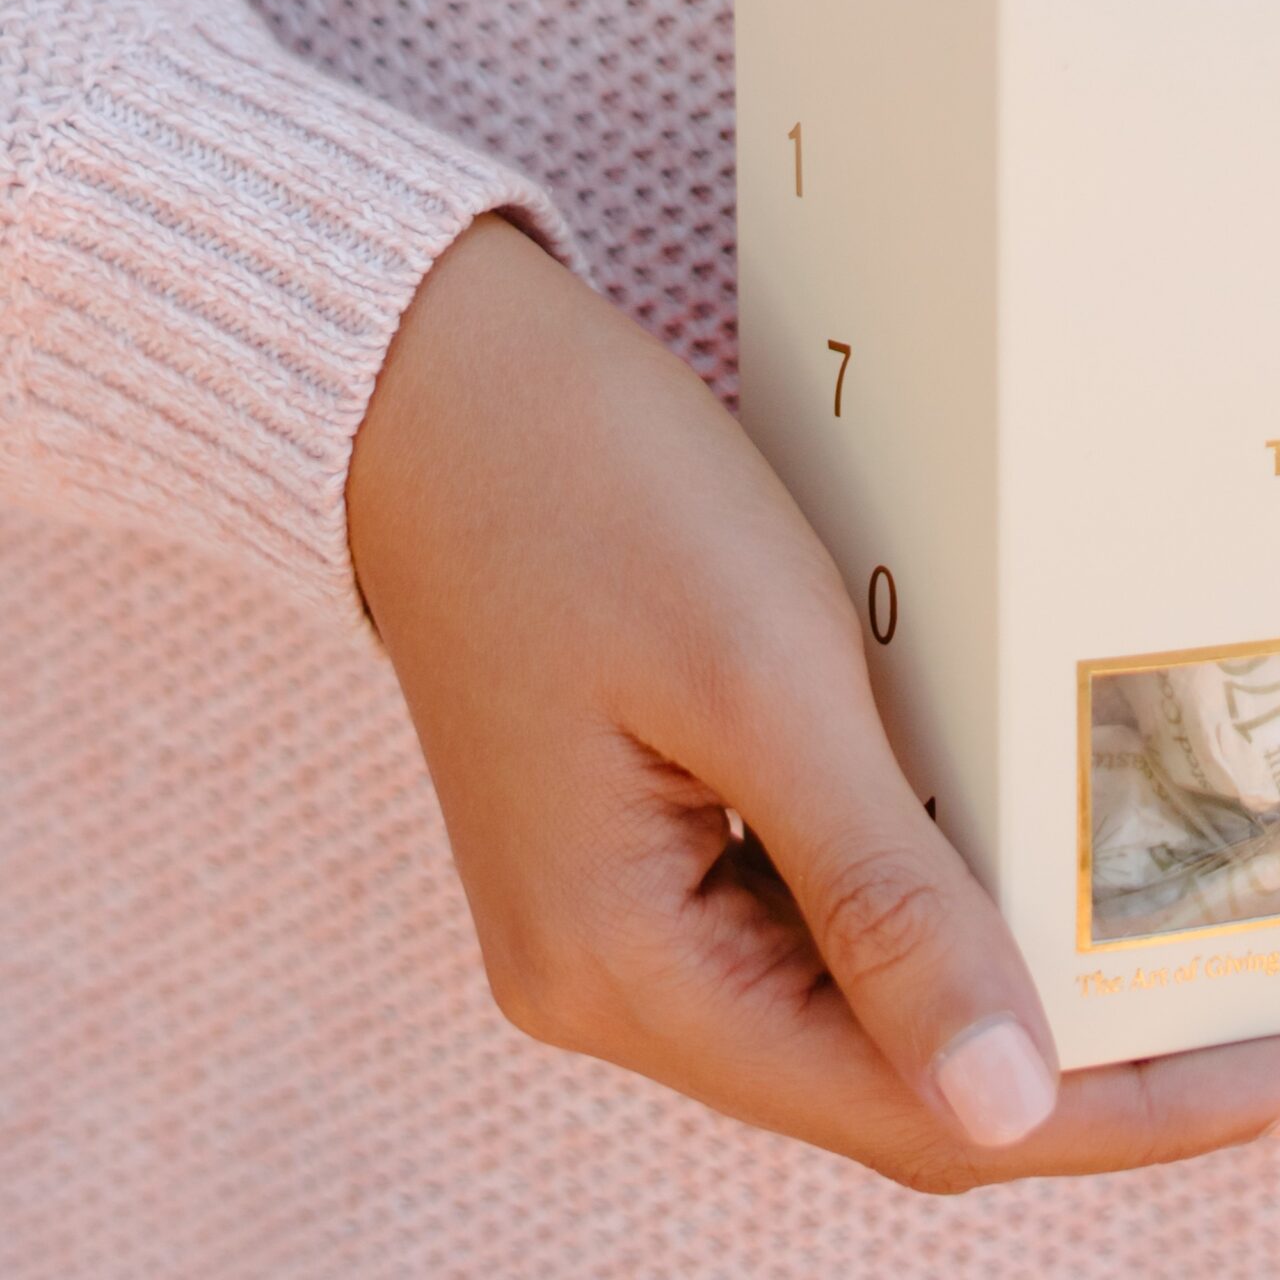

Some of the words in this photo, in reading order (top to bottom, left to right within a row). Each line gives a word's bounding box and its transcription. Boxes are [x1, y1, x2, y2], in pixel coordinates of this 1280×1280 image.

[788, 121, 803, 198] 1
[826, 338, 851, 418] 7
[868, 565, 898, 646] 0
[1075, 969, 1122, 999] The
[1130, 967, 1168, 992] Art
[1173, 956, 1201, 983] of
